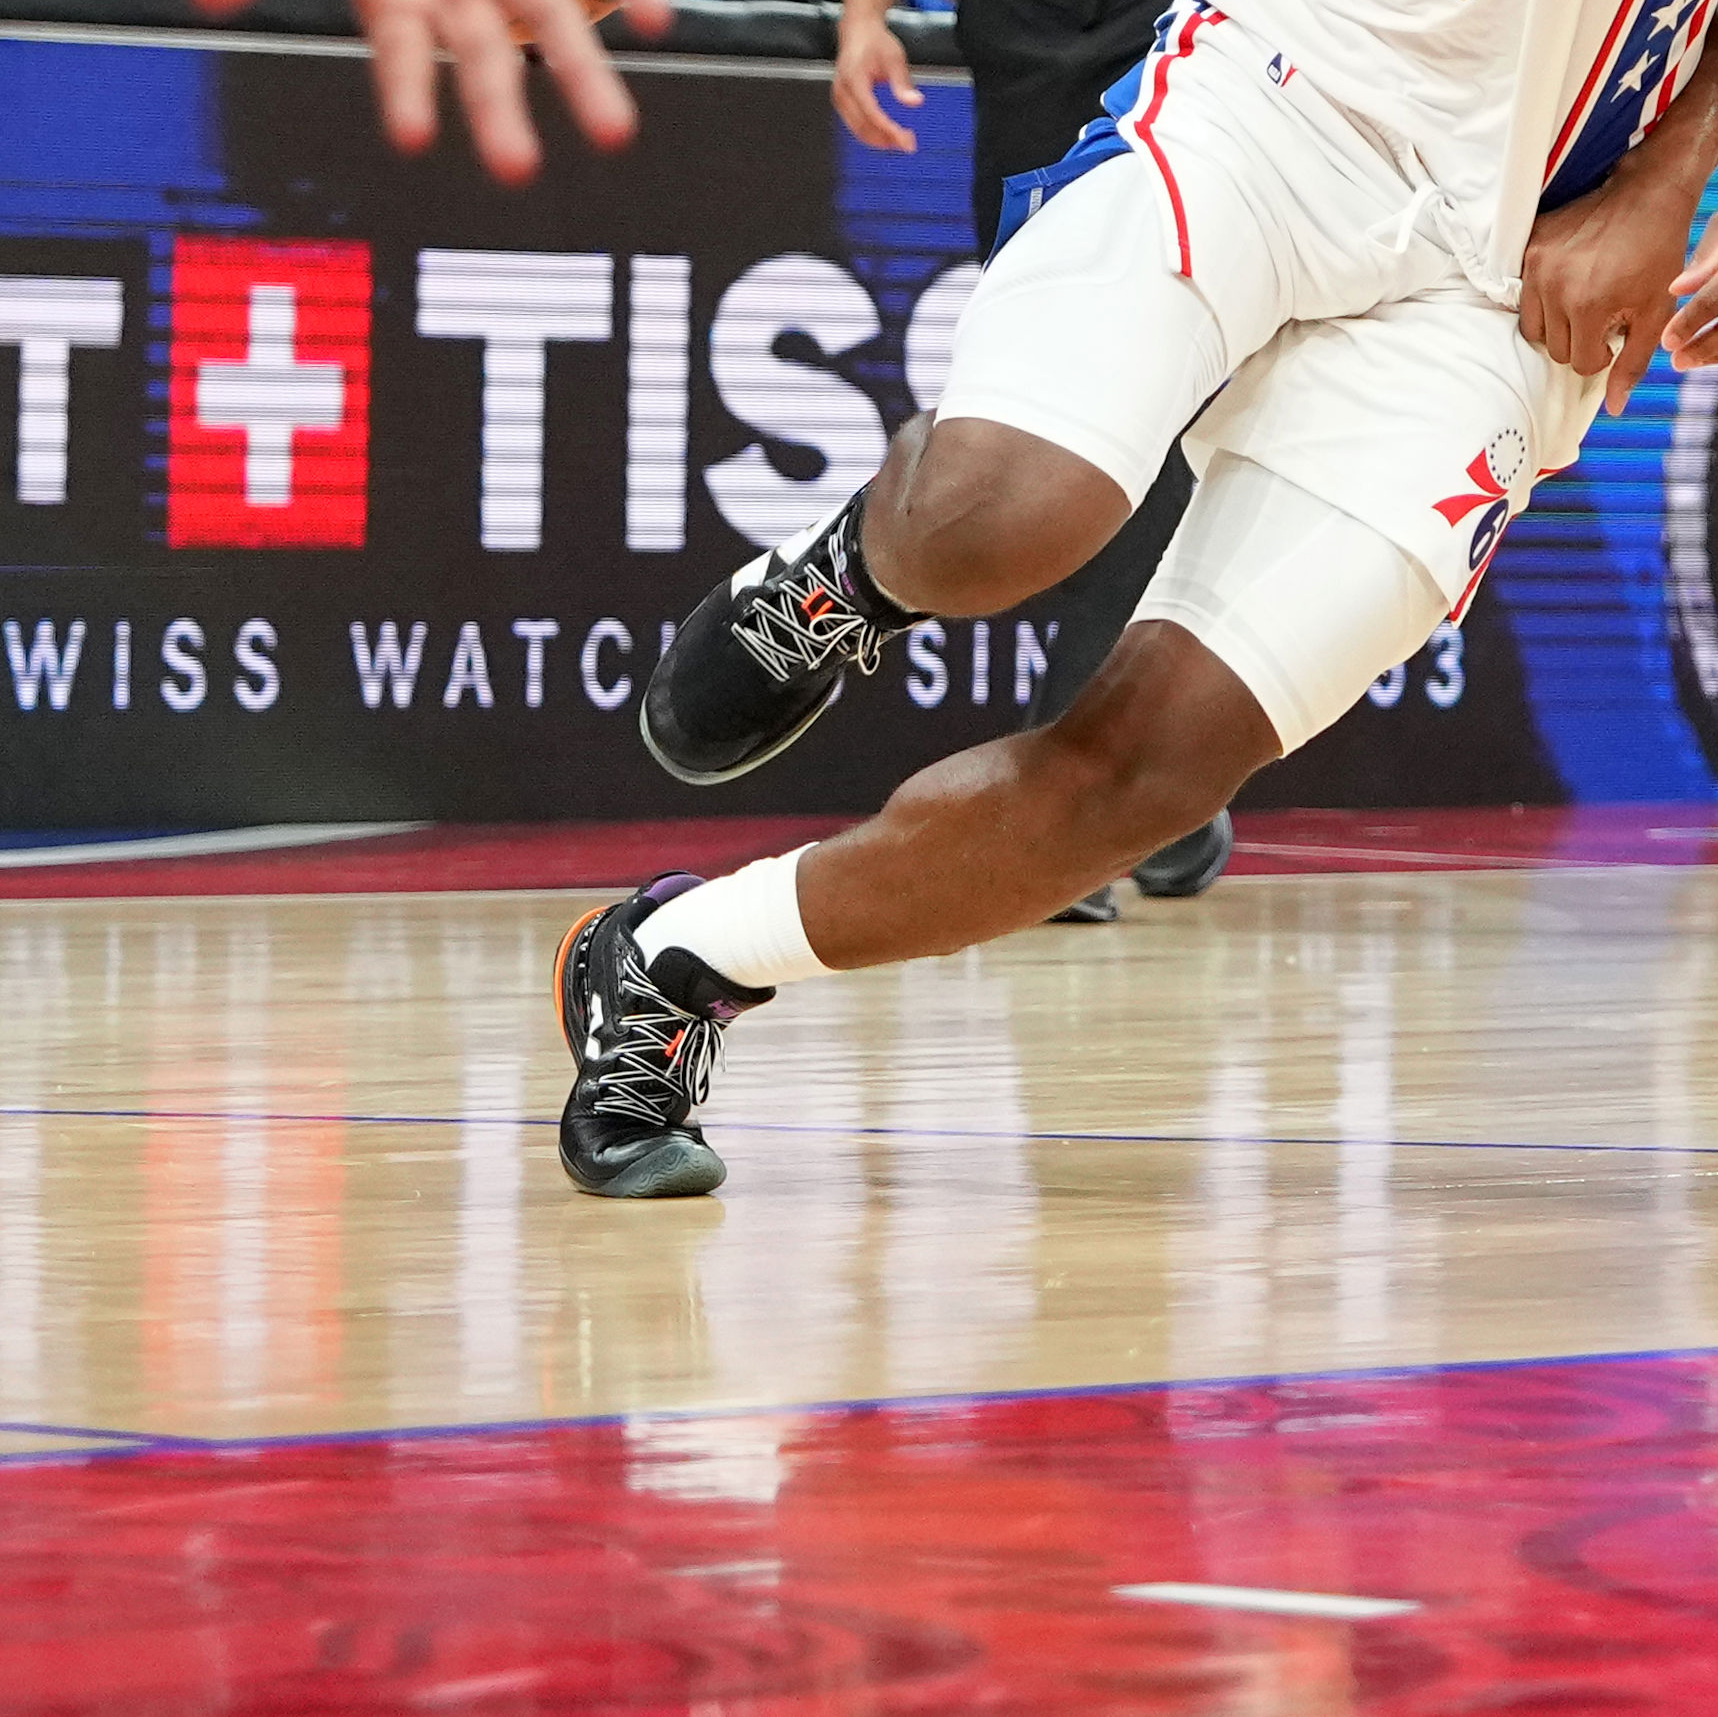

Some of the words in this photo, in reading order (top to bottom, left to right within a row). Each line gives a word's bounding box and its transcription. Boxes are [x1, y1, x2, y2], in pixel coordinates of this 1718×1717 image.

[415, 248, 981, 552] TIS
[2, 616, 281, 711] WISS
[349, 616, 845, 711] WATC
[906, 617, 1060, 710] SIN
